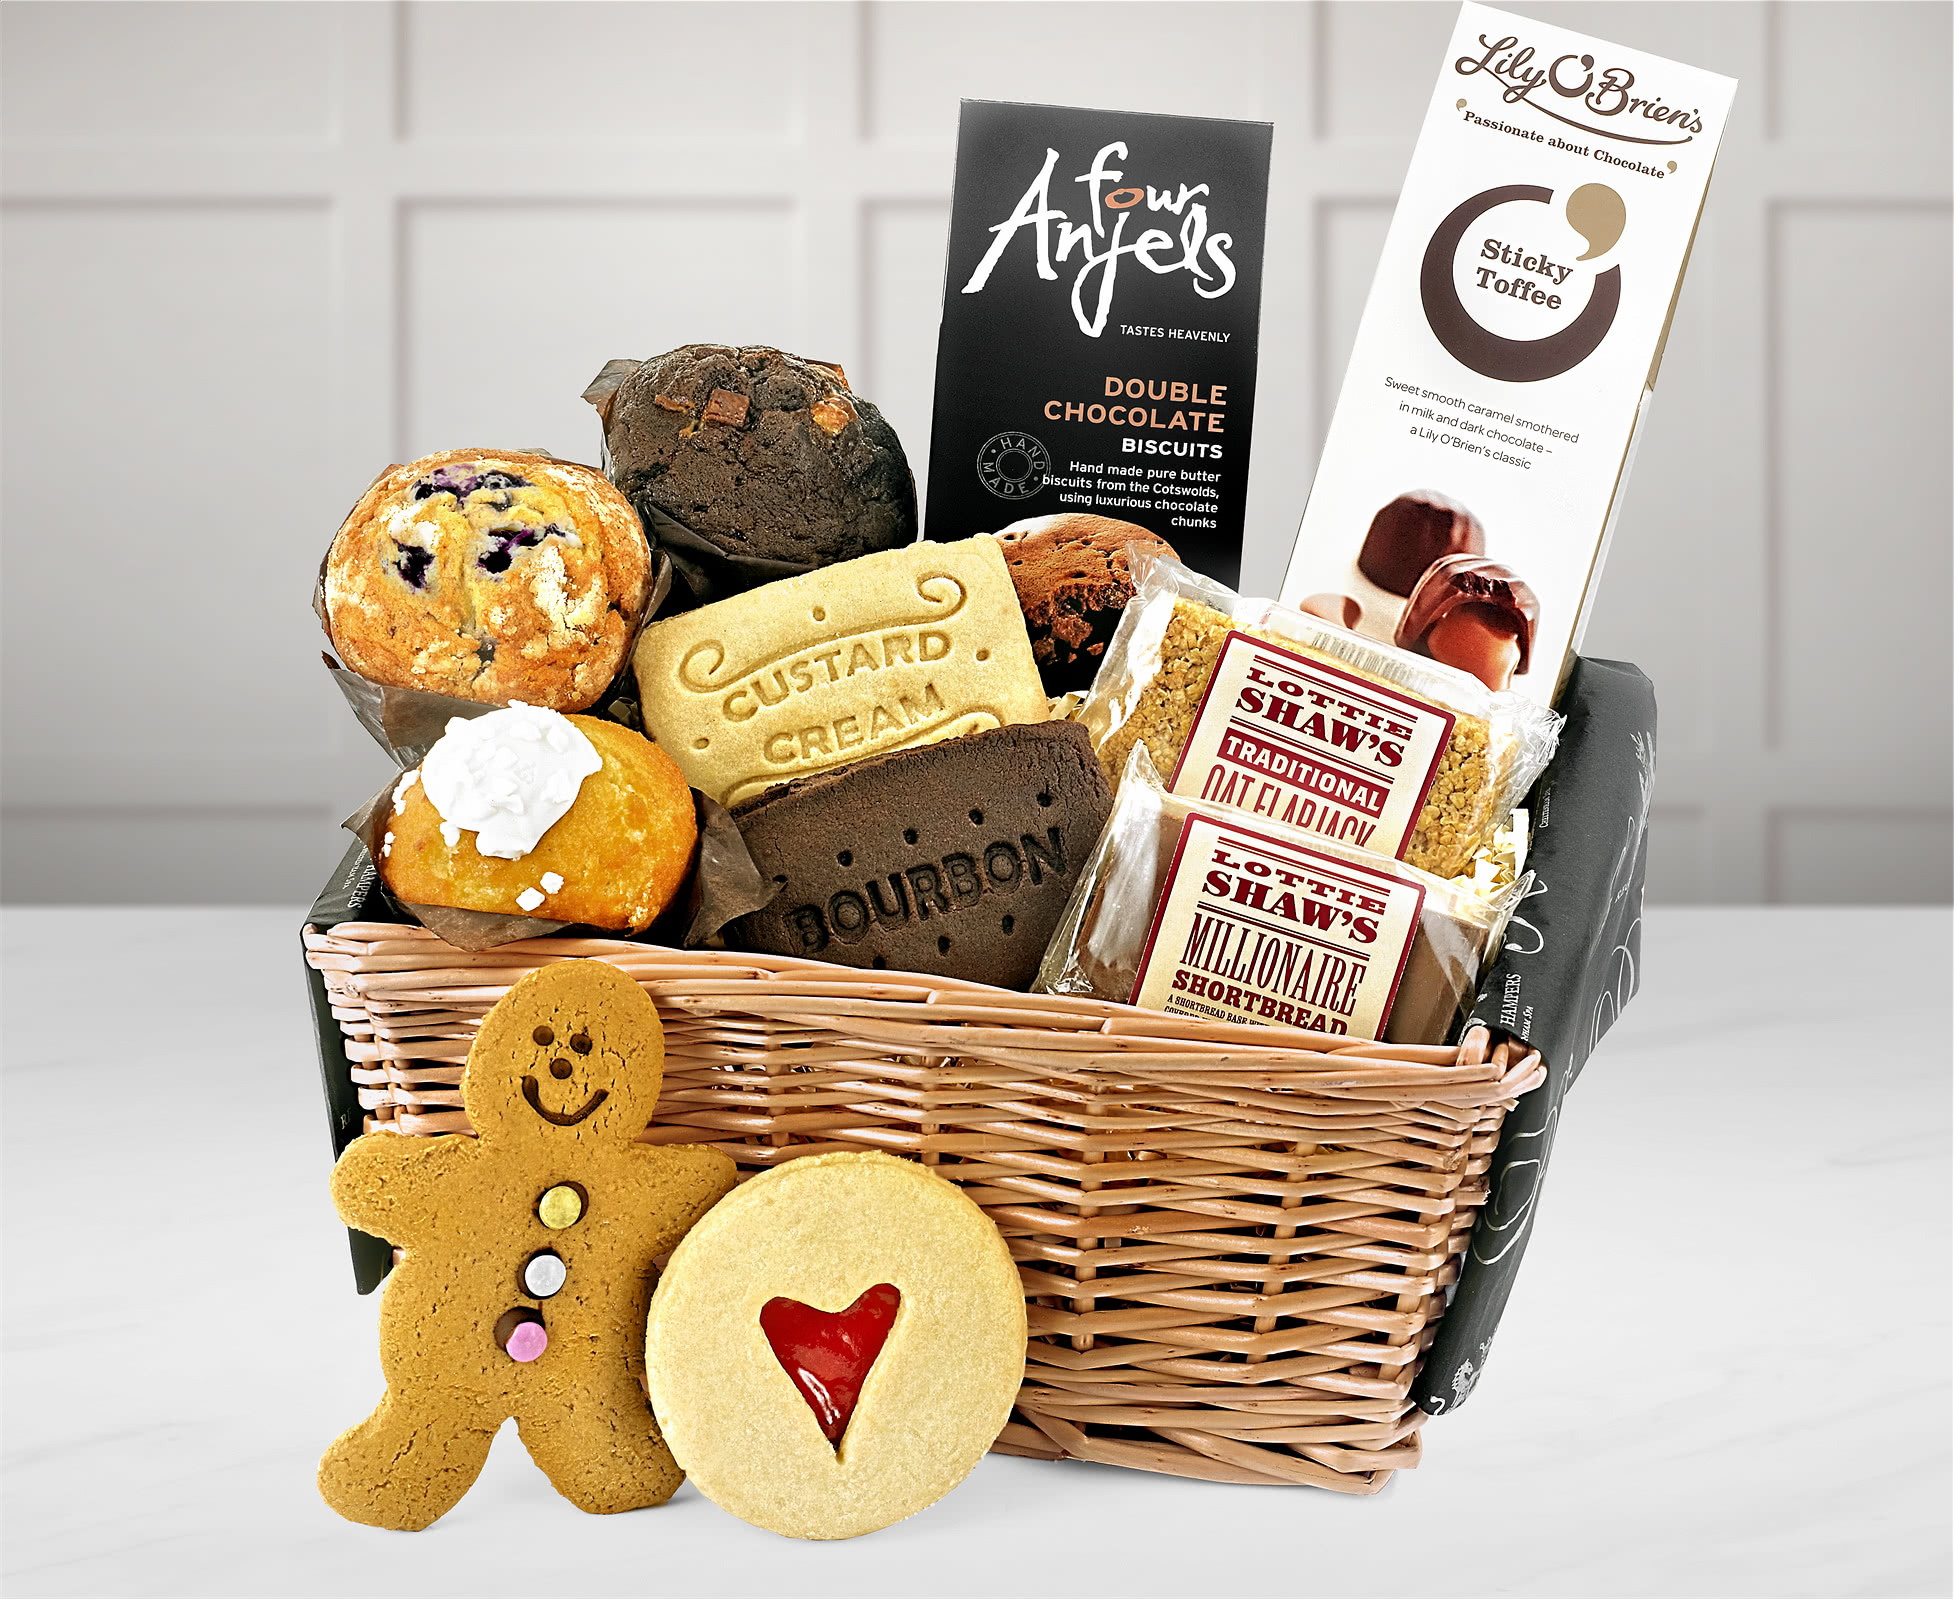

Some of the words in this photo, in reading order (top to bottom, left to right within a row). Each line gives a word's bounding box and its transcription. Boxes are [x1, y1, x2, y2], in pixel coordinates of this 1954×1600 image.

[1455, 34, 1547, 103] Lily
[1549, 54, 1702, 133] O'Brien's
[1463, 110, 1544, 143] Passionate
[1548, 136, 1589, 157] about
[1593, 149, 1665, 179] Chocolate
[1075, 141, 1209, 238] four
[1476, 267, 1562, 310] Toffee
[1480, 238, 1573, 285] Sticky
[1120, 324, 1165, 339] TASTES
[1168, 327, 1231, 343] HEAVENLY
[1043, 400, 1225, 433] CHOCOLATE
[1104, 376, 1228, 406] DOUBLE
[1384, 376, 1421, 397] Sweet
[1421, 388, 1466, 410] smooth
[1467, 403, 1515, 424] caramel
[1515, 416, 1580, 444] smothered
[1000, 436, 1046, 471] HAND
[1121, 438, 1223, 459] BISCUITS
[1399, 400, 1410, 412] in
[1411, 406, 1435, 421] milk
[1435, 413, 1459, 428] and
[1459, 419, 1485, 436] dark
[1486, 428, 1544, 454] chocolate
[1409, 426, 1417, 436] a
[1419, 427, 1439, 444] Lily
[1440, 433, 1491, 458] O'Brien's
[1492, 449, 1532, 470] classic
[982, 461, 1029, 495] MADE
[1042, 474, 1092, 489] biscuits
[1096, 479, 1126, 491] from
[1129, 481, 1149, 493] the
[1153, 483, 1220, 499] Cotswolds,
[1069, 461, 1103, 474] Hand
[1107, 464, 1143, 477] made
[1147, 468, 1177, 481] pure
[1180, 469, 1221, 483] butter
[1059, 492, 1093, 507] using
[1096, 493, 1152, 509] luxurious
[1154, 498, 1218, 513] chocolate
[1171, 516, 1217, 529] chunks
[722, 630, 951, 723] CUSTARD
[1246, 666, 1413, 741] LOTTIE
[763, 683, 945, 765] CREAM
[1234, 686, 1405, 768] SHAW'S
[1225, 735, 1382, 813] TRADITIONAL
[784, 826, 1066, 955] BOURBON
[1202, 869, 1378, 944] SHAW'S
[1211, 849, 1387, 916] LOTTIE
[1179, 912, 1367, 1017] MILLIONAIRE
[1167, 994, 1174, 1004] A
[1174, 995, 1226, 1019] SHORTBREAD
[1226, 1012, 1248, 1025] BASE
[1171, 968, 1348, 1036] SHORTBREAD
[1500, 973, 1521, 1027] HAMPERS
